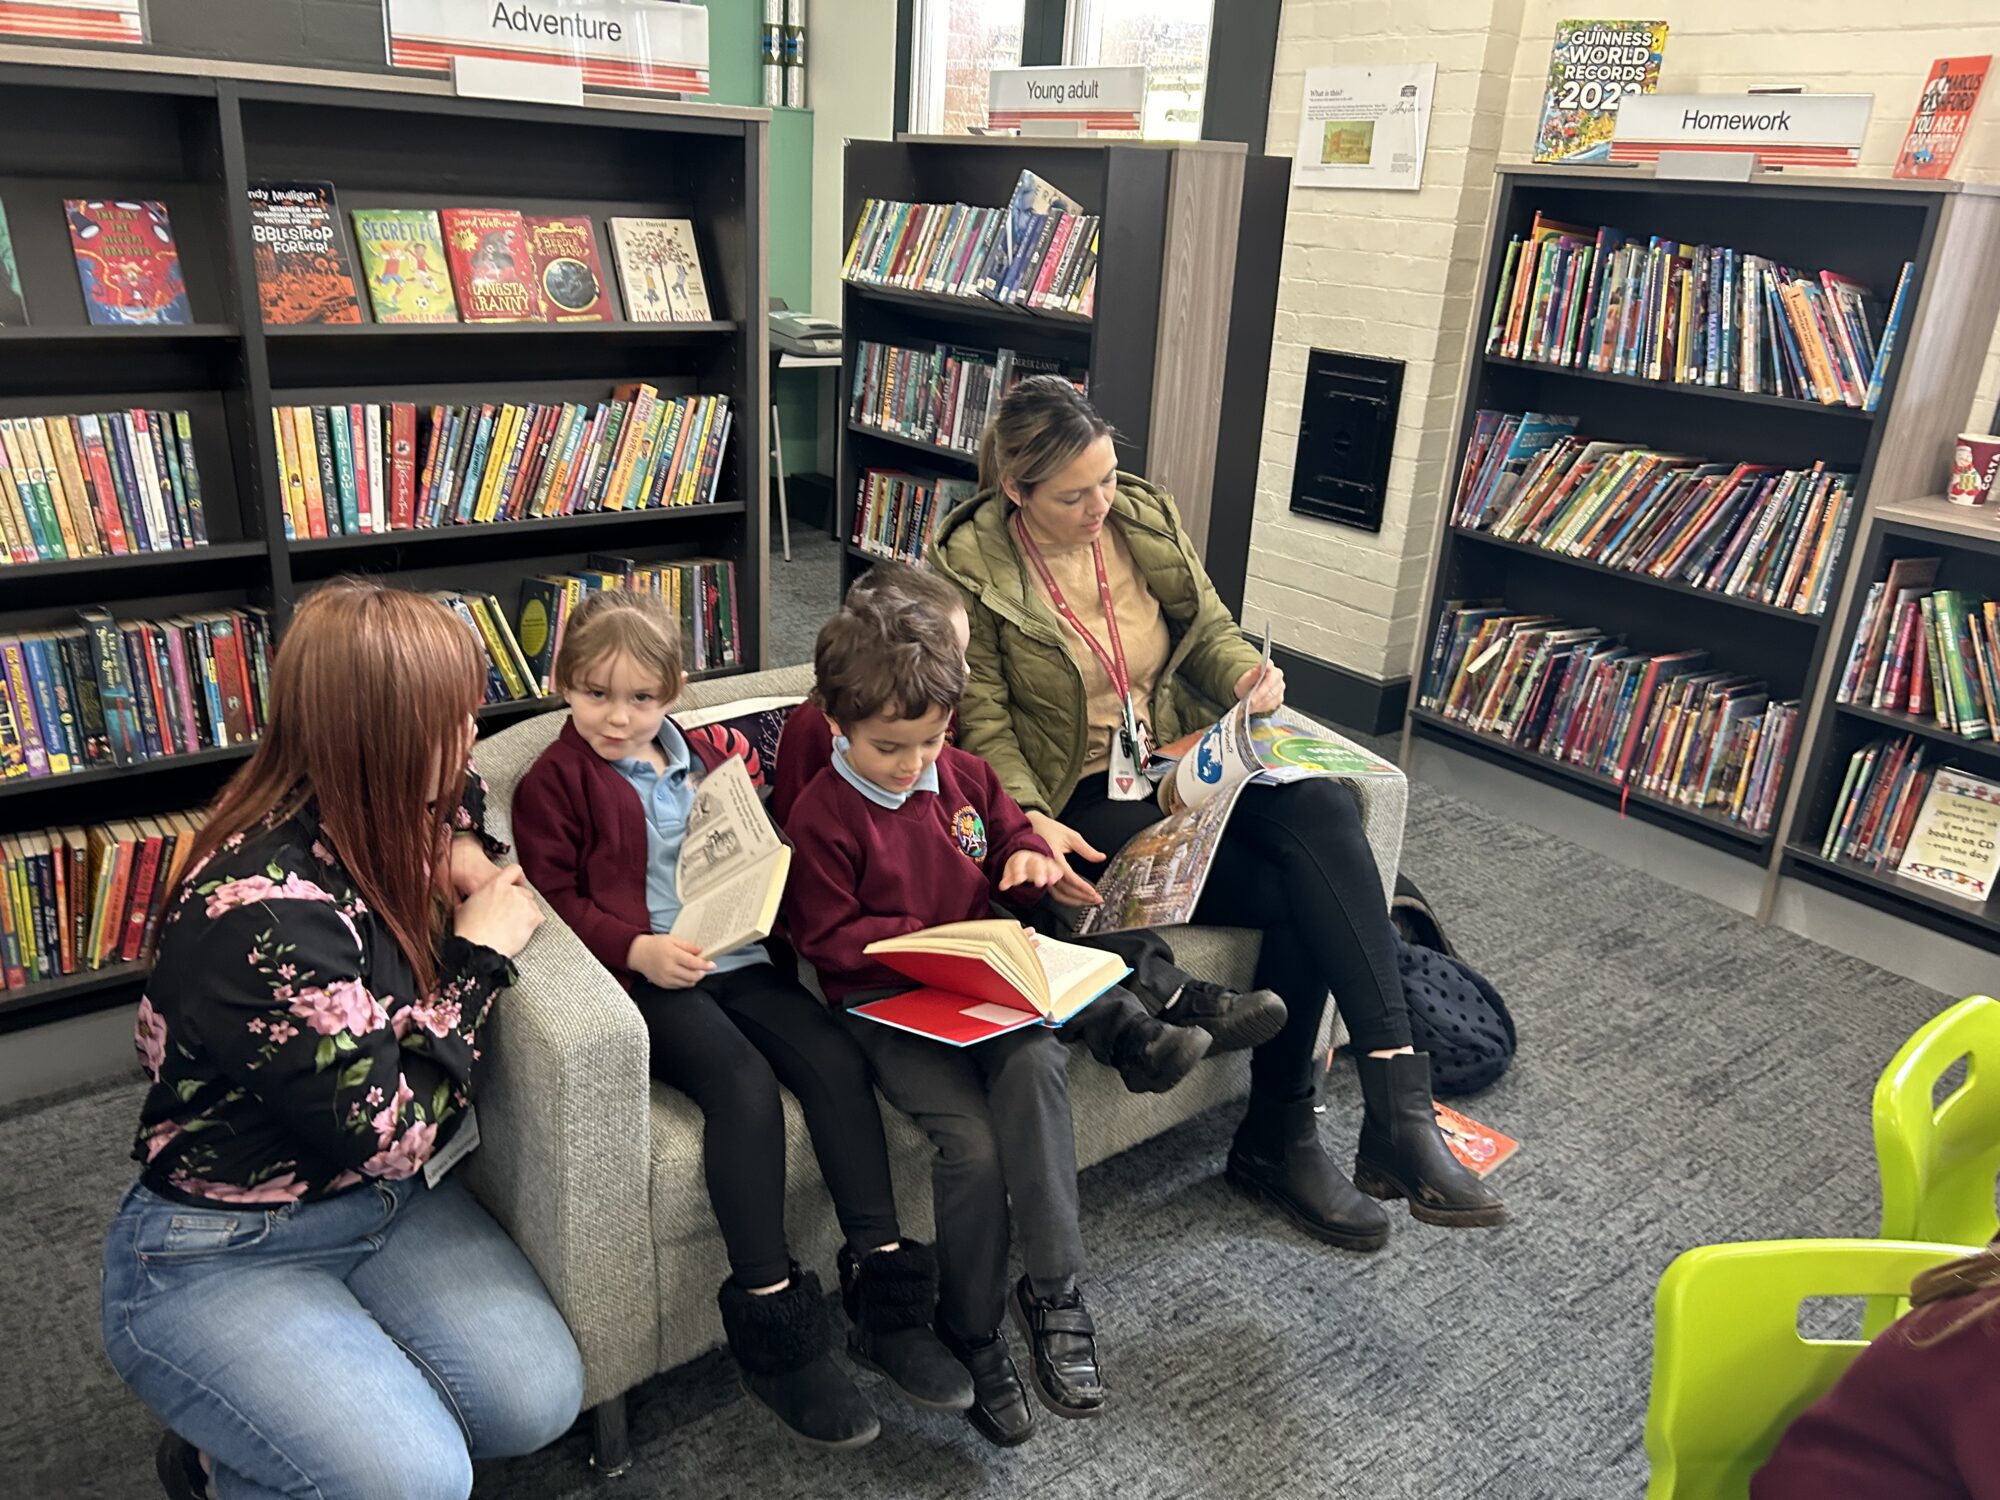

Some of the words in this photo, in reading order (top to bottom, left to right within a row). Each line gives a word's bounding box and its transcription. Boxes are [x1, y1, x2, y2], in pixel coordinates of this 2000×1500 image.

[491, 3, 622, 42] Adventure
[1571, 31, 1653, 46] GUINNESS
[1569, 46, 1650, 65] WORLD
[1564, 65, 1647, 81] RECORDS
[1944, 74, 1984, 91] MARCUS
[1027, 80, 1064, 103] Young
[1067, 80, 1099, 99] adult
[1330, 89, 1344, 97] this?
[1920, 92, 1976, 112] RASHFORD
[1681, 109, 1792, 131] Homework
[1914, 114, 1934, 133] YOU
[1933, 114, 1958, 133] ARE
[1955, 114, 1967, 132] A
[247, 188, 269, 201] ndy
[271, 188, 317, 203] Mulligan
[362, 220, 416, 242] SECRET
[1981, 453, 2000, 491] COSTA
[1927, 827, 1960, 843] books
[1961, 836, 1975, 847] on
[1978, 838, 1995, 850] CD
[1968, 849, 1990, 863] dog
